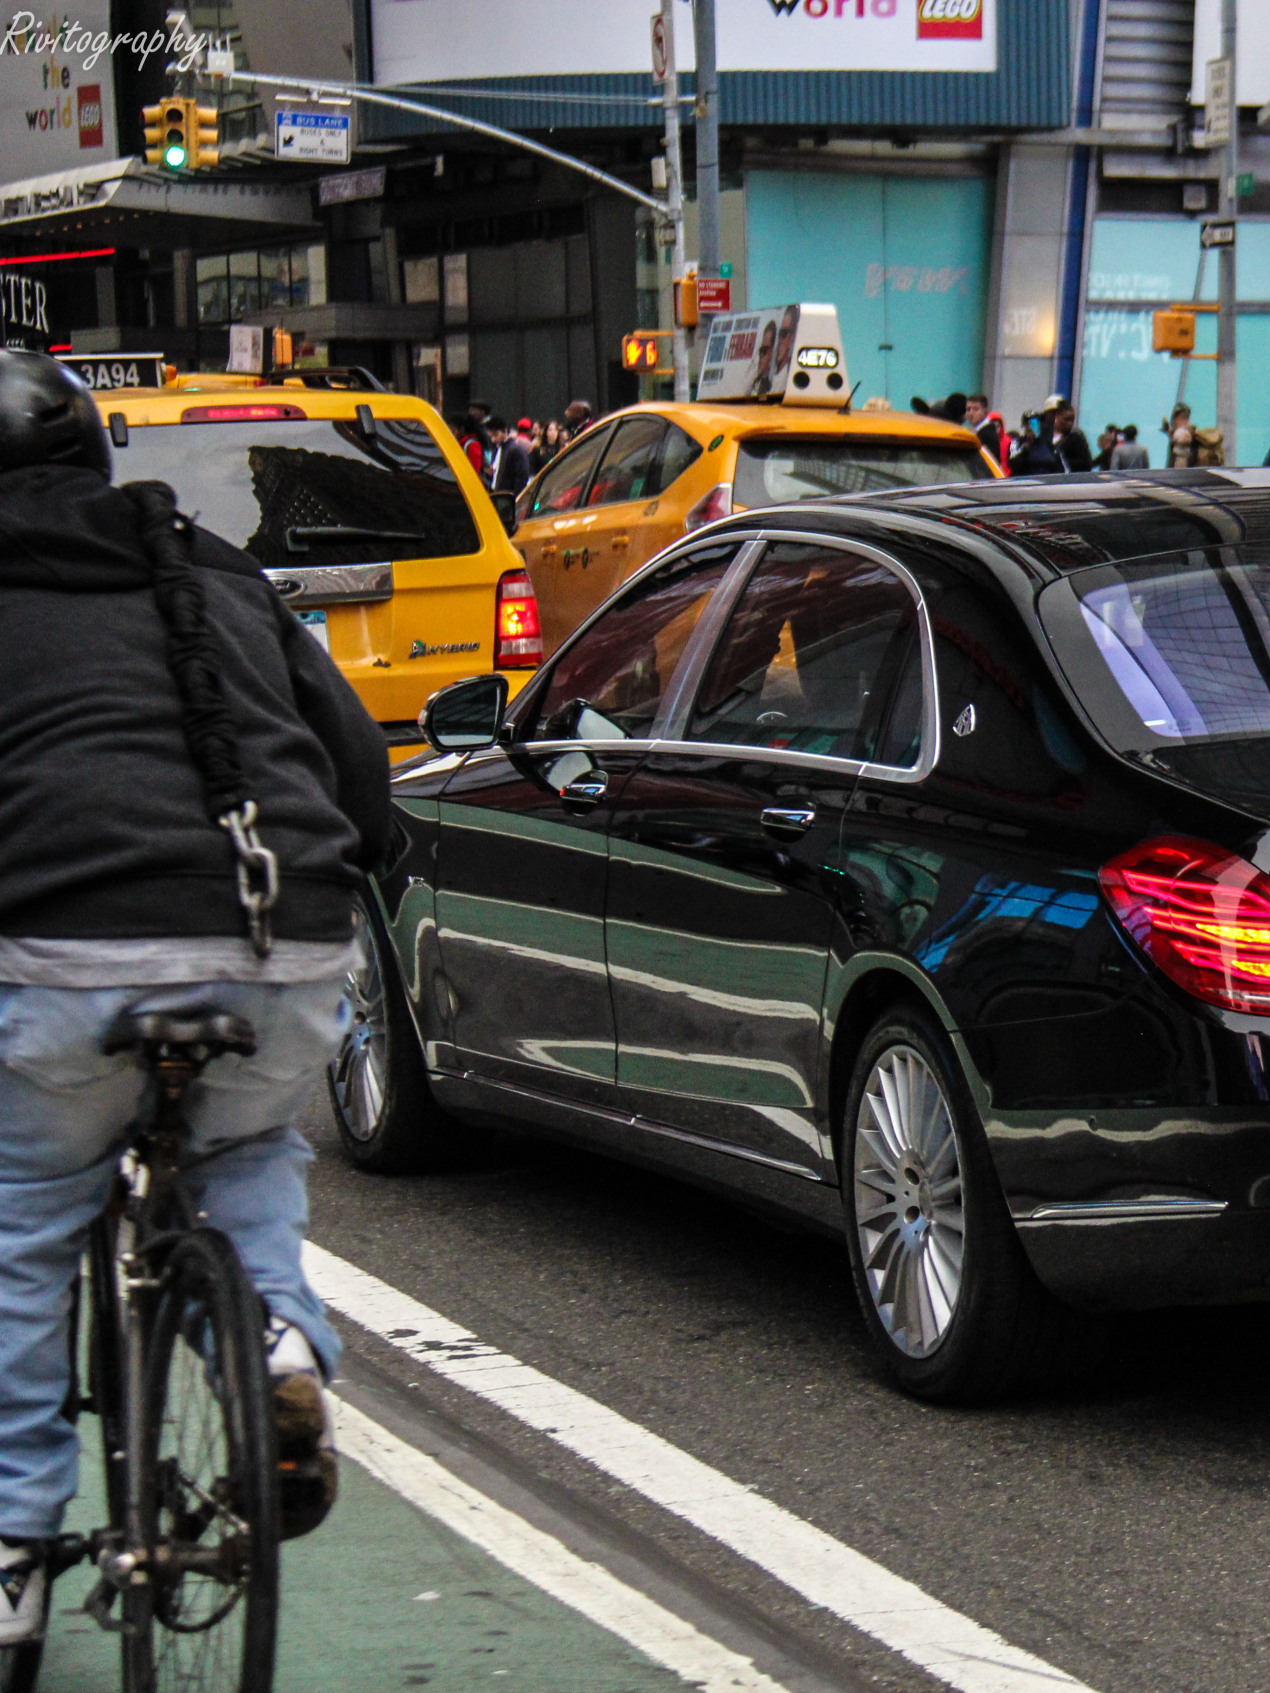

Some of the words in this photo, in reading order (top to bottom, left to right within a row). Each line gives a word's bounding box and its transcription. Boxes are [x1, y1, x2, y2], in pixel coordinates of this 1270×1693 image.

[920, 0, 979, 19] LEGO
[26, 95, 72, 131] world
[296, 116, 316, 126] BUS
[318, 117, 343, 127] LANE
[797, 350, 838, 367] 4E76
[81, 362, 140, 388] 3A94
[428, 641, 480, 655] HYBRID
